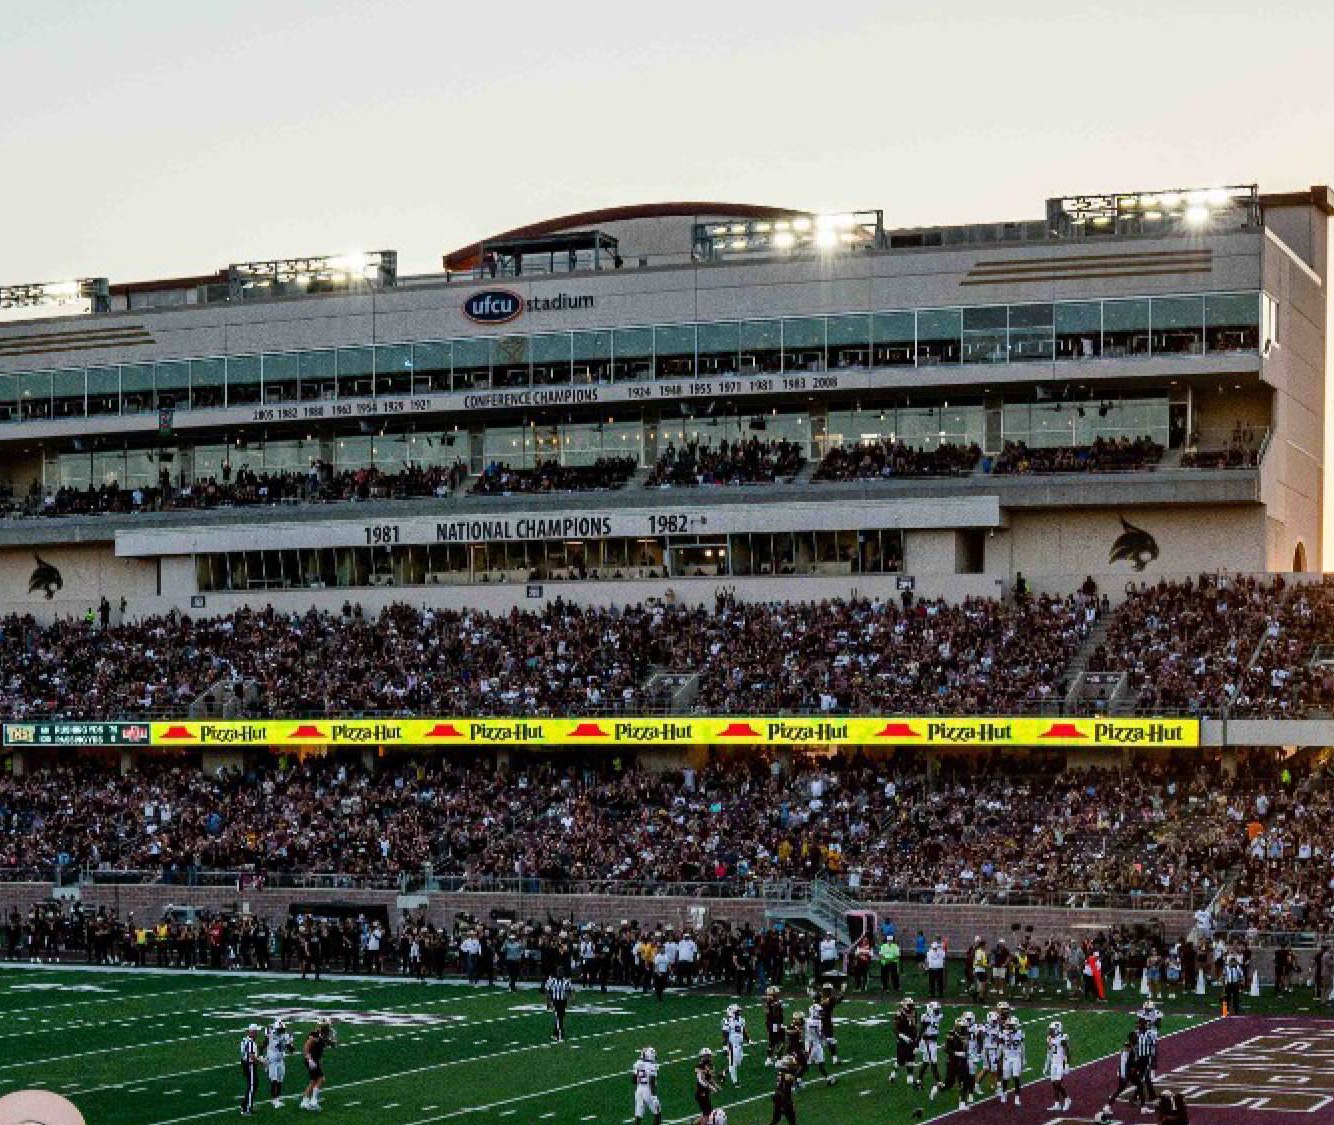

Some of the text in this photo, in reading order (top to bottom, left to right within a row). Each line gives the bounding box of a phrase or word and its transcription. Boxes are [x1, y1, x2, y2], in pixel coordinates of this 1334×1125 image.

[472, 292, 594, 315] ufcu stadium
[464, 393, 531, 409] CONFERENCE
[533, 388, 598, 404] CHAMPIONS
[812, 376, 838, 388] 2008
[364, 514, 688, 544] 1981 NATIONAL CHAMPIONS 1982
[200, 725, 267, 742] Pizza Hut
[331, 725, 402, 742] Pizza Hut
[470, 724, 544, 742] Pizza Hut
[615, 723, 693, 741] Pizza Hut
[767, 723, 848, 741] Pizza Hut
[927, 723, 1013, 742] Pizza Hut
[1094, 724, 1183, 742] Pizza Hut
